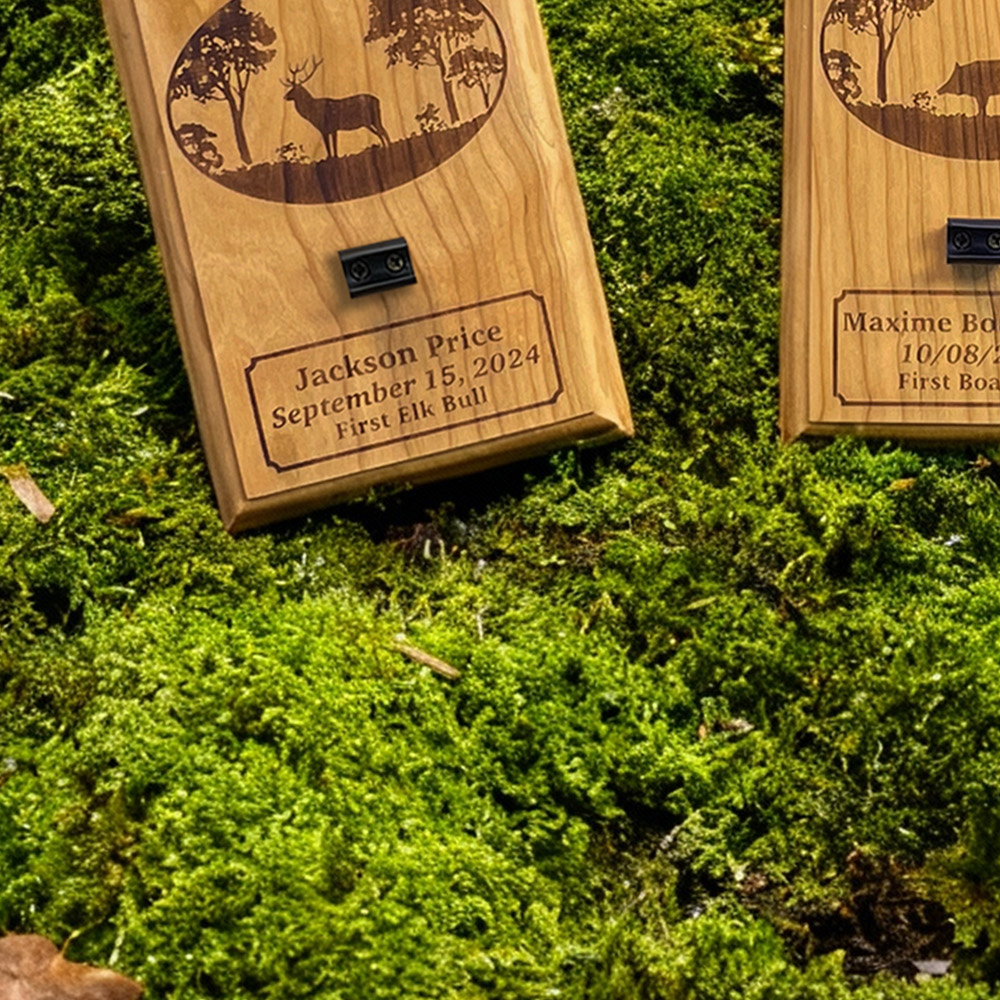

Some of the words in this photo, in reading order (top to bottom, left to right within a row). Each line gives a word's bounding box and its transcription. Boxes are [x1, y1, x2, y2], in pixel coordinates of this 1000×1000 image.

[843, 311, 952, 333] Maxime
[295, 345, 418, 391] Jackson
[426, 325, 504, 358] Price
[899, 372, 951, 390] First
[272, 377, 417, 429] September
[425, 364, 465, 390] 15,
[473, 344, 541, 379] 2024
[336, 412, 390, 440] First
[398, 402, 436, 425] Elk
[442, 386, 488, 412] Bull
